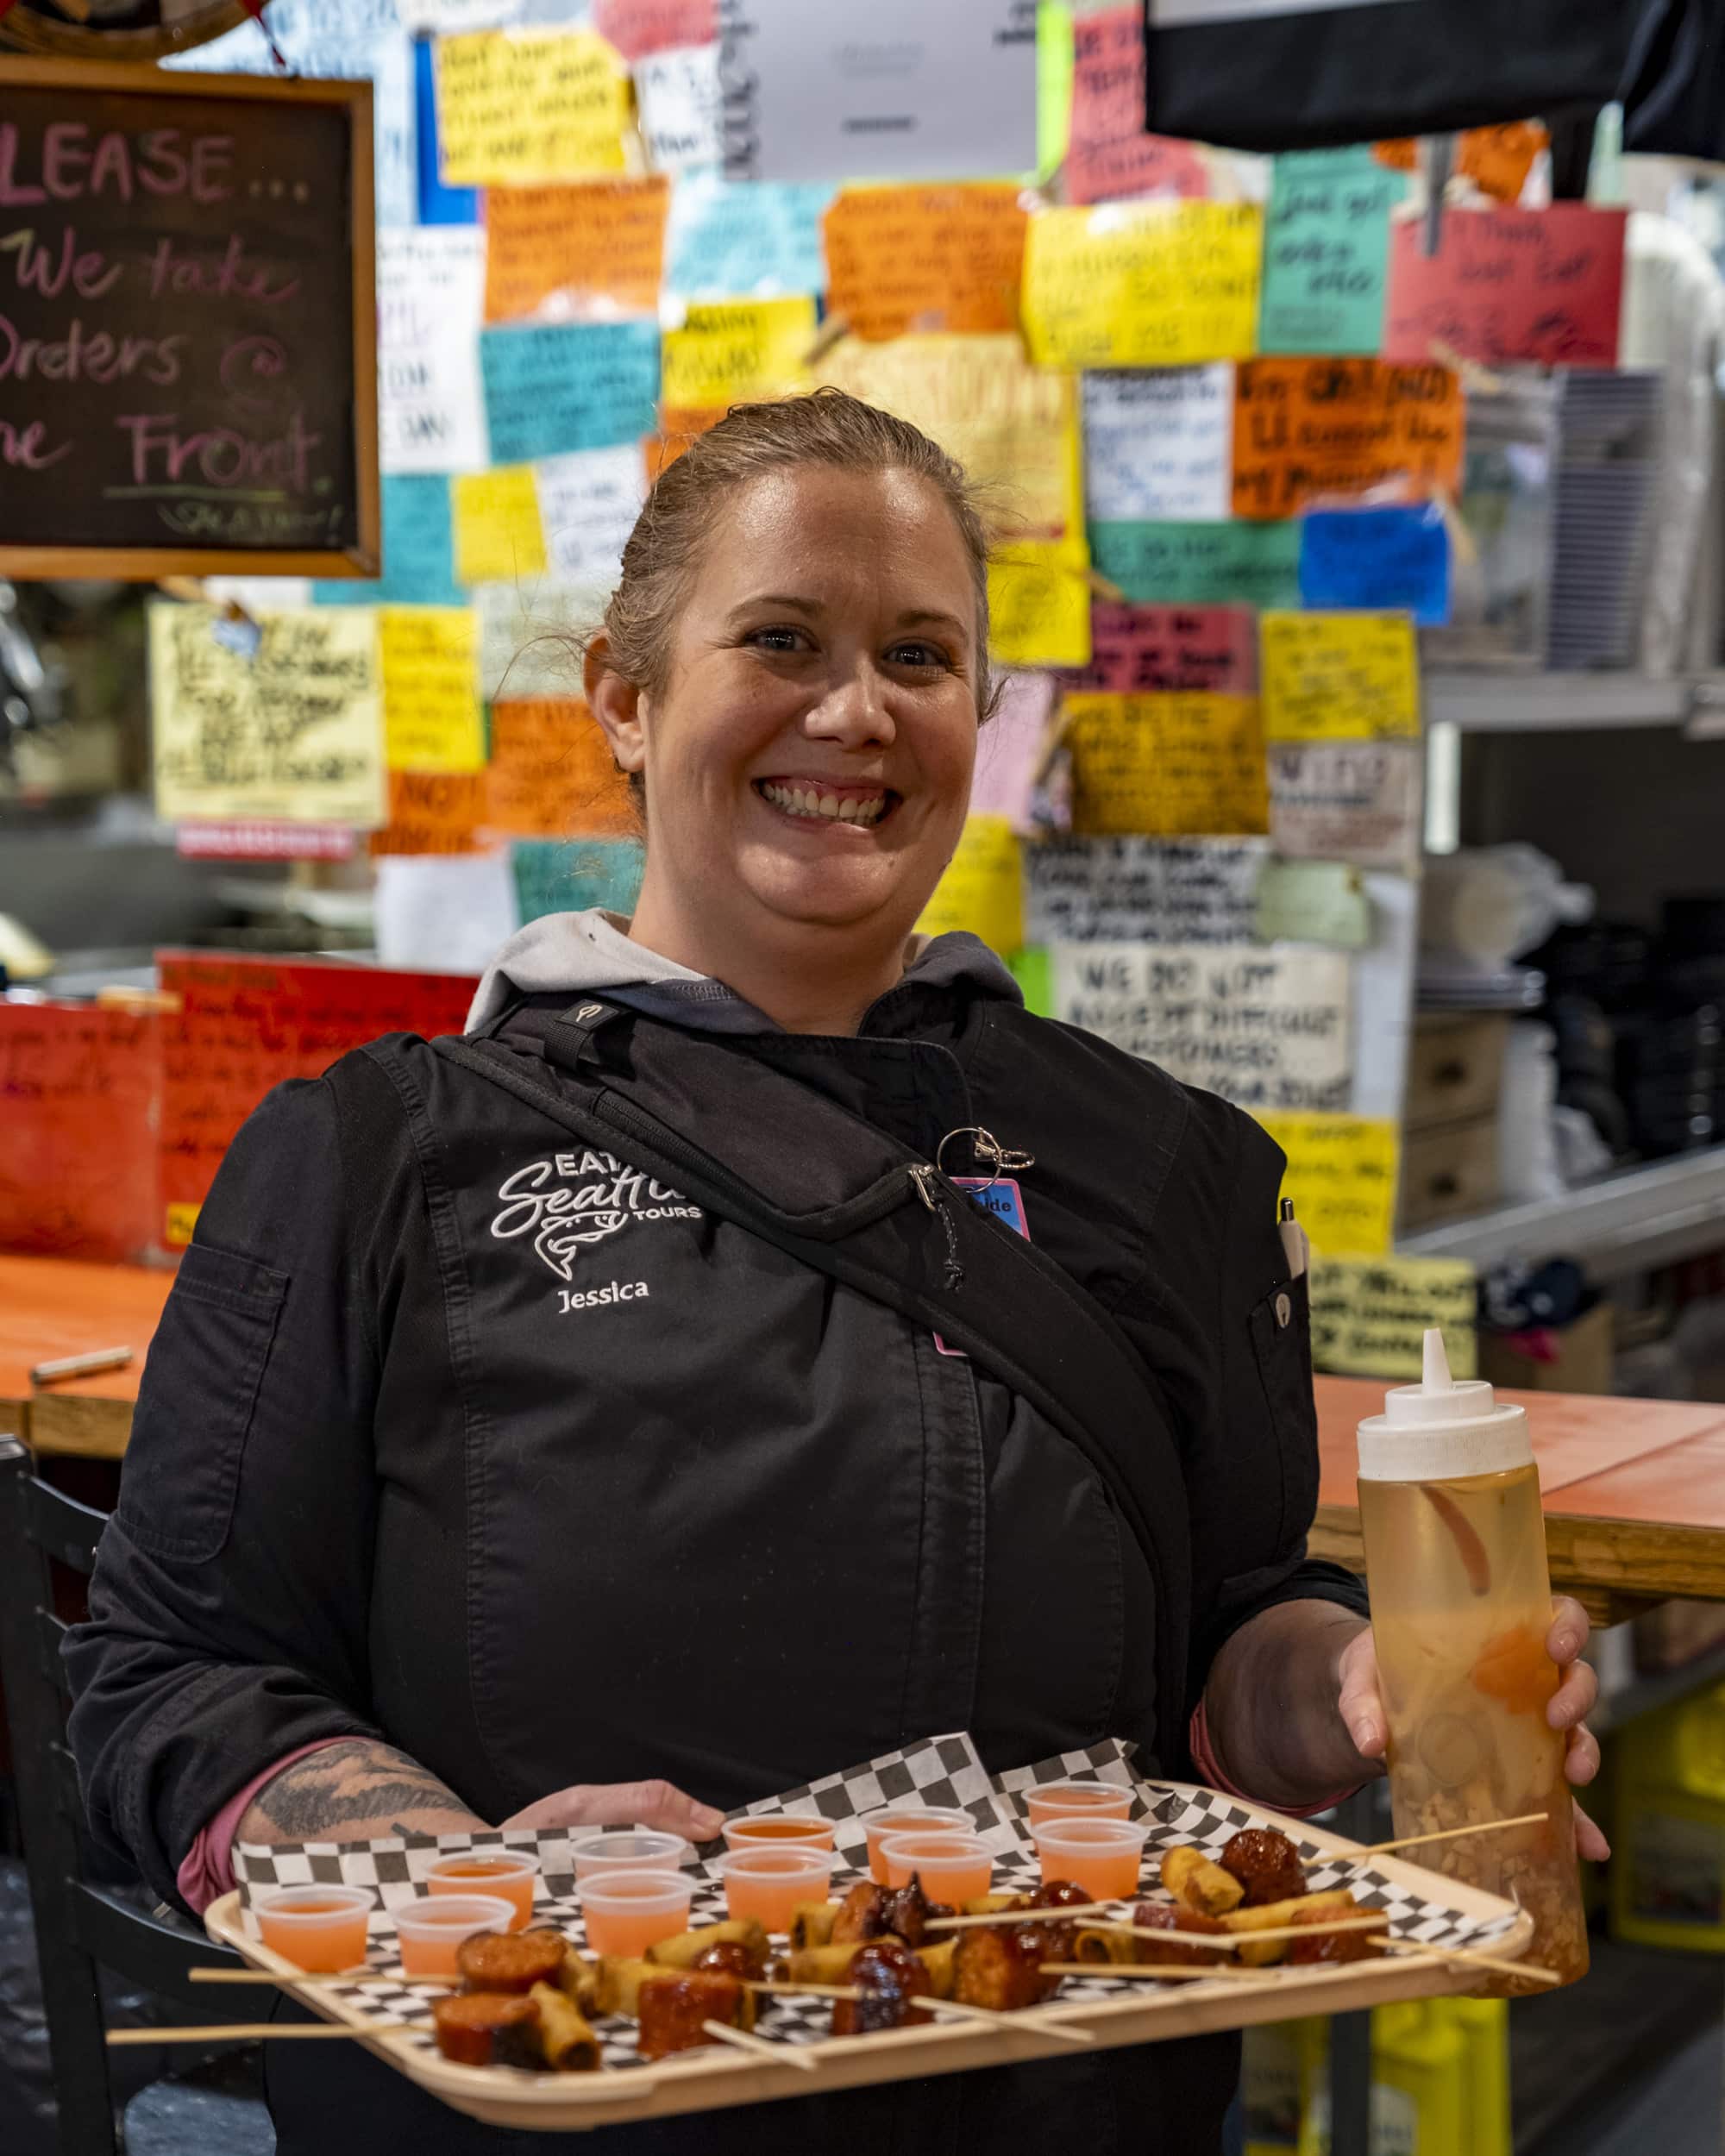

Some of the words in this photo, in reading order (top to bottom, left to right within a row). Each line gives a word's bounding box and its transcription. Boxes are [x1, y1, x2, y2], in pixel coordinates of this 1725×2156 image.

[0, 121, 310, 205] LEASE...
[14, 226, 123, 299] We
[491, 1161, 687, 1238] Seatt
[632, 1206, 703, 1221] TOURS
[557, 1281, 649, 1314] Jessica
